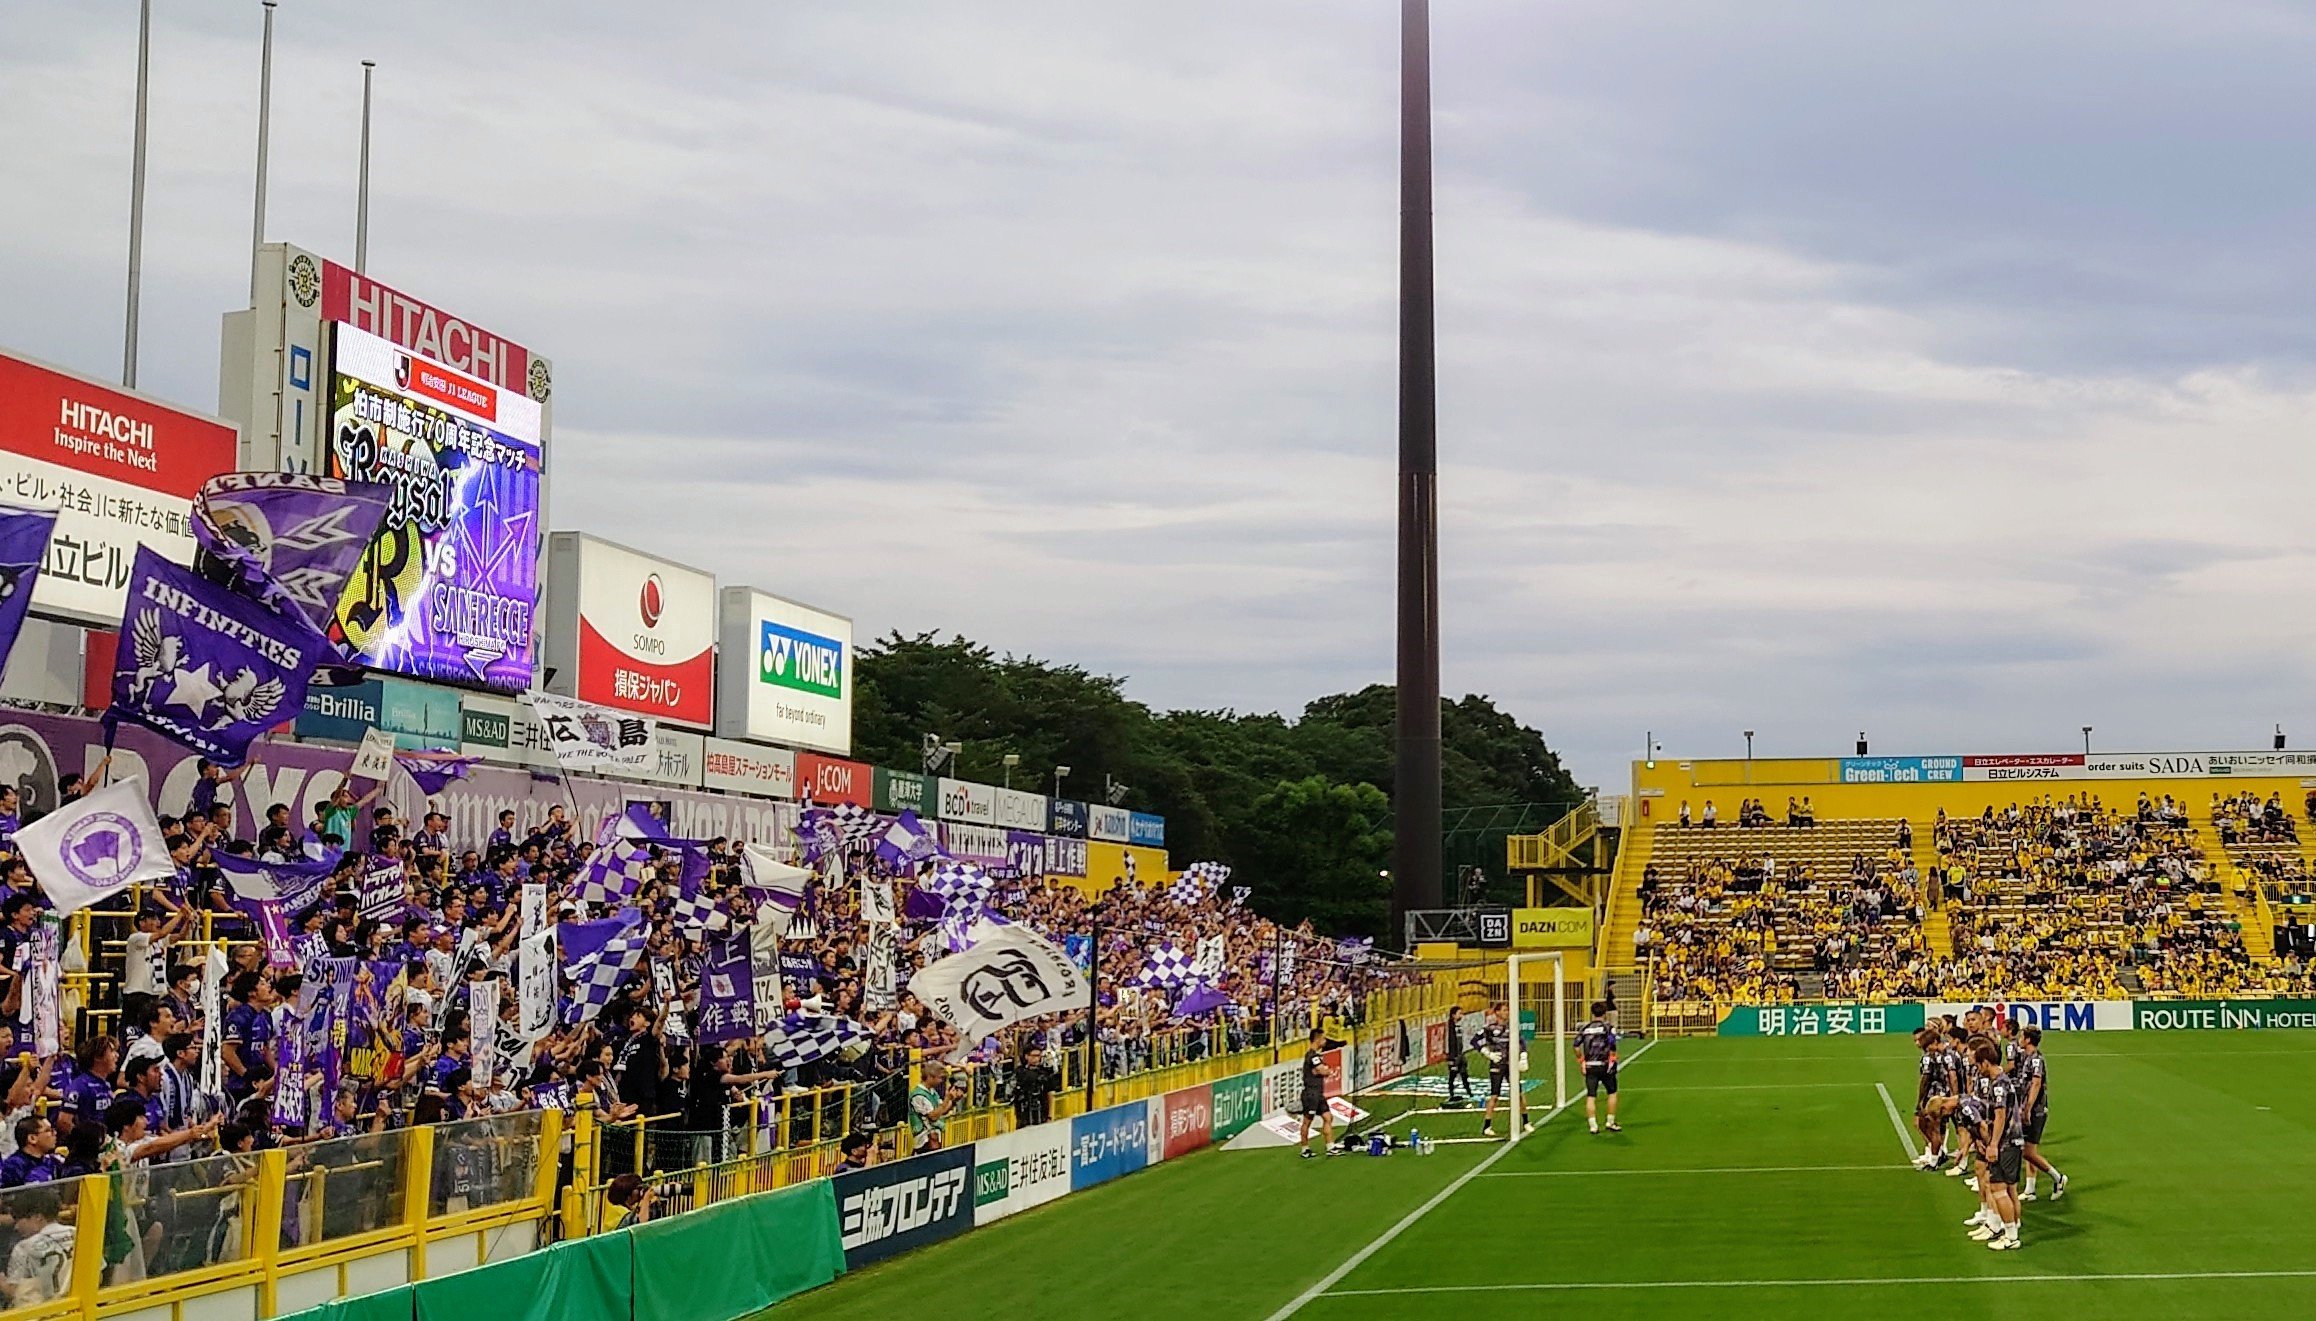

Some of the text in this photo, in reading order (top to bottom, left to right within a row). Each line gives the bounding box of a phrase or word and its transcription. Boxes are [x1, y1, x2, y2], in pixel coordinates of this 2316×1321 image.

[349, 275, 507, 390] HITACHI
[457, 386, 488, 408] LEAGUE
[60, 398, 153, 449] HITACHI
[353, 388, 527, 473] 柏市制施行70周年記念マッチ
[54, 427, 157, 472] Inspire the Next
[0, 472, 194, 538] ・ビル・社会」に新たな価値
[39, 534, 129, 590] 立ビル
[425, 540, 456, 577] VS
[142, 575, 302, 670] INFINITIES
[432, 582, 530, 646] SANFRECCE
[633, 634, 665, 656] SOMPO
[792, 640, 839, 689] YONEX
[614, 668, 681, 707] 損保ジャパン
[320, 693, 375, 722] Brillia
[466, 716, 507, 741] MS&AD
[617, 718, 649, 749] 島
[1846, 767, 1919, 782] Green-Tech
[1921, 758, 1957, 769] GROUND
[1927, 769, 1953, 780] CREW
[1974, 757, 2074, 766] 日立エレベーター・エスカレーター
[1988, 768, 2060, 779] 日立ビルシステム
[2088, 761, 2116, 771] order
[2119, 761, 2145, 771] suits
[2149, 757, 2204, 774] SADA
[815, 762, 852, 796] J:COM
[945, 793, 989, 816] BCD travel
[1001, 795, 1044, 825] MEGALOS
[1758, 1007, 1887, 1036] 明治安田
[1972, 1002, 2095, 1031] iDEM
[2140, 1009, 2216, 1029] ROUTE
[1213, 1085, 1260, 1131] 日立ハイテク
[1072, 1119, 1146, 1168] 一富士フードサービス
[975, 1145, 1067, 1198] MS&AD 三井住友海上
[841, 1165, 967, 1251] 三協フロンテア
